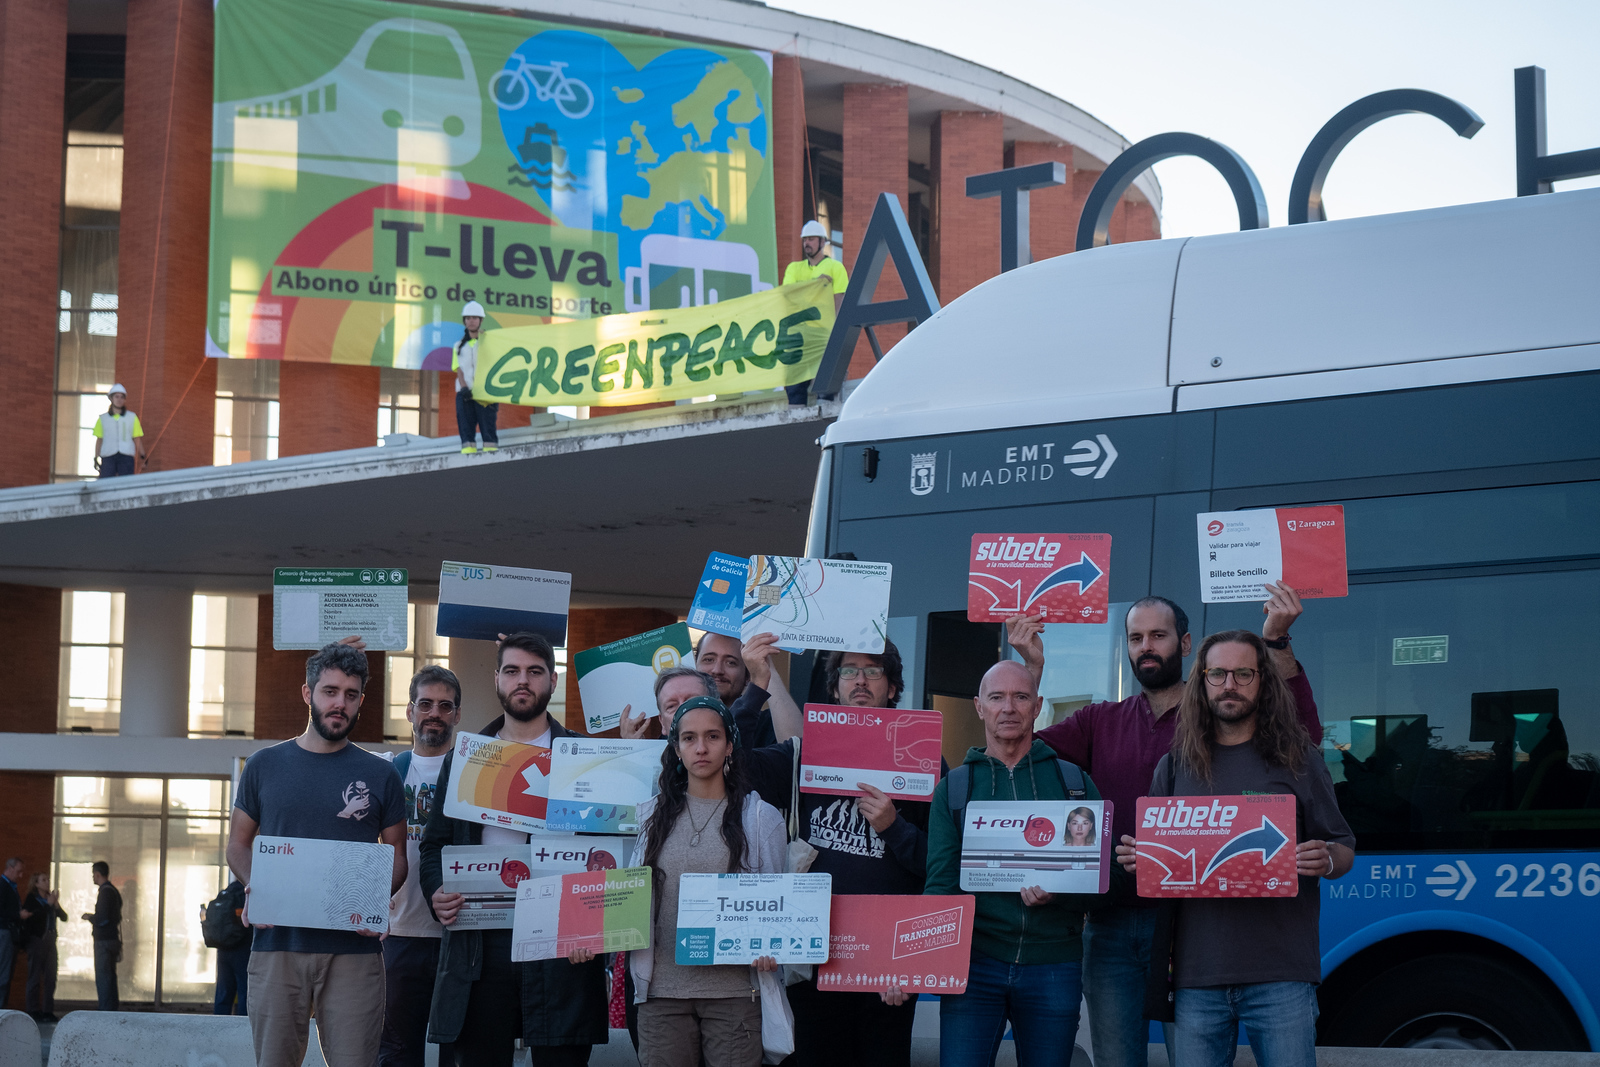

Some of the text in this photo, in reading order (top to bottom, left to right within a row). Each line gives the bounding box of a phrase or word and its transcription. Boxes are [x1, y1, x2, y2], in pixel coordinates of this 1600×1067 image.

[382, 220, 612, 288] T-lleva
[277, 271, 612, 316] Abono único de transporte
[484, 307, 821, 404] GREENPEACE
[1006, 443, 1055, 464] EMT
[962, 464, 1054, 488] MADRID
[1298, 520, 1335, 529] Zaragoza
[975, 536, 1061, 561] súbete
[714, 557, 749, 570] transporte
[721, 565, 743, 576] Galicia
[462, 567, 484, 580] TUS
[496, 574, 533, 582] AYUNTAMIENTO
[1237, 568, 1268, 577] Sencillo
[707, 612, 730, 624] XUNTA
[715, 621, 742, 633] GALICIA
[780, 632, 845, 645] JUNTA DE EXTREMADURA
[469, 748, 502, 762] VALENCIANA
[470, 740, 503, 756] GENERALITAT
[815, 773, 843, 782] Logroño
[1142, 799, 1238, 828] súbete
[990, 814, 1044, 833] renfe
[259, 842, 294, 855] barik
[553, 847, 605, 866] renfe
[832, 842, 886, 858] DARKSDE
[468, 857, 518, 876] renfe
[1371, 864, 1417, 880] EMT
[572, 877, 645, 895] BonoMurcia
[1495, 862, 1600, 898] 2236
[1330, 883, 1417, 899] MADRID
[716, 896, 784, 912] T-usual
[366, 915, 382, 924] ctb
[912, 912, 957, 930] CONSORCIO
[900, 922, 956, 943] TRANSPORTES
[924, 933, 955, 948] MADRID
[829, 943, 870, 951] transporte
